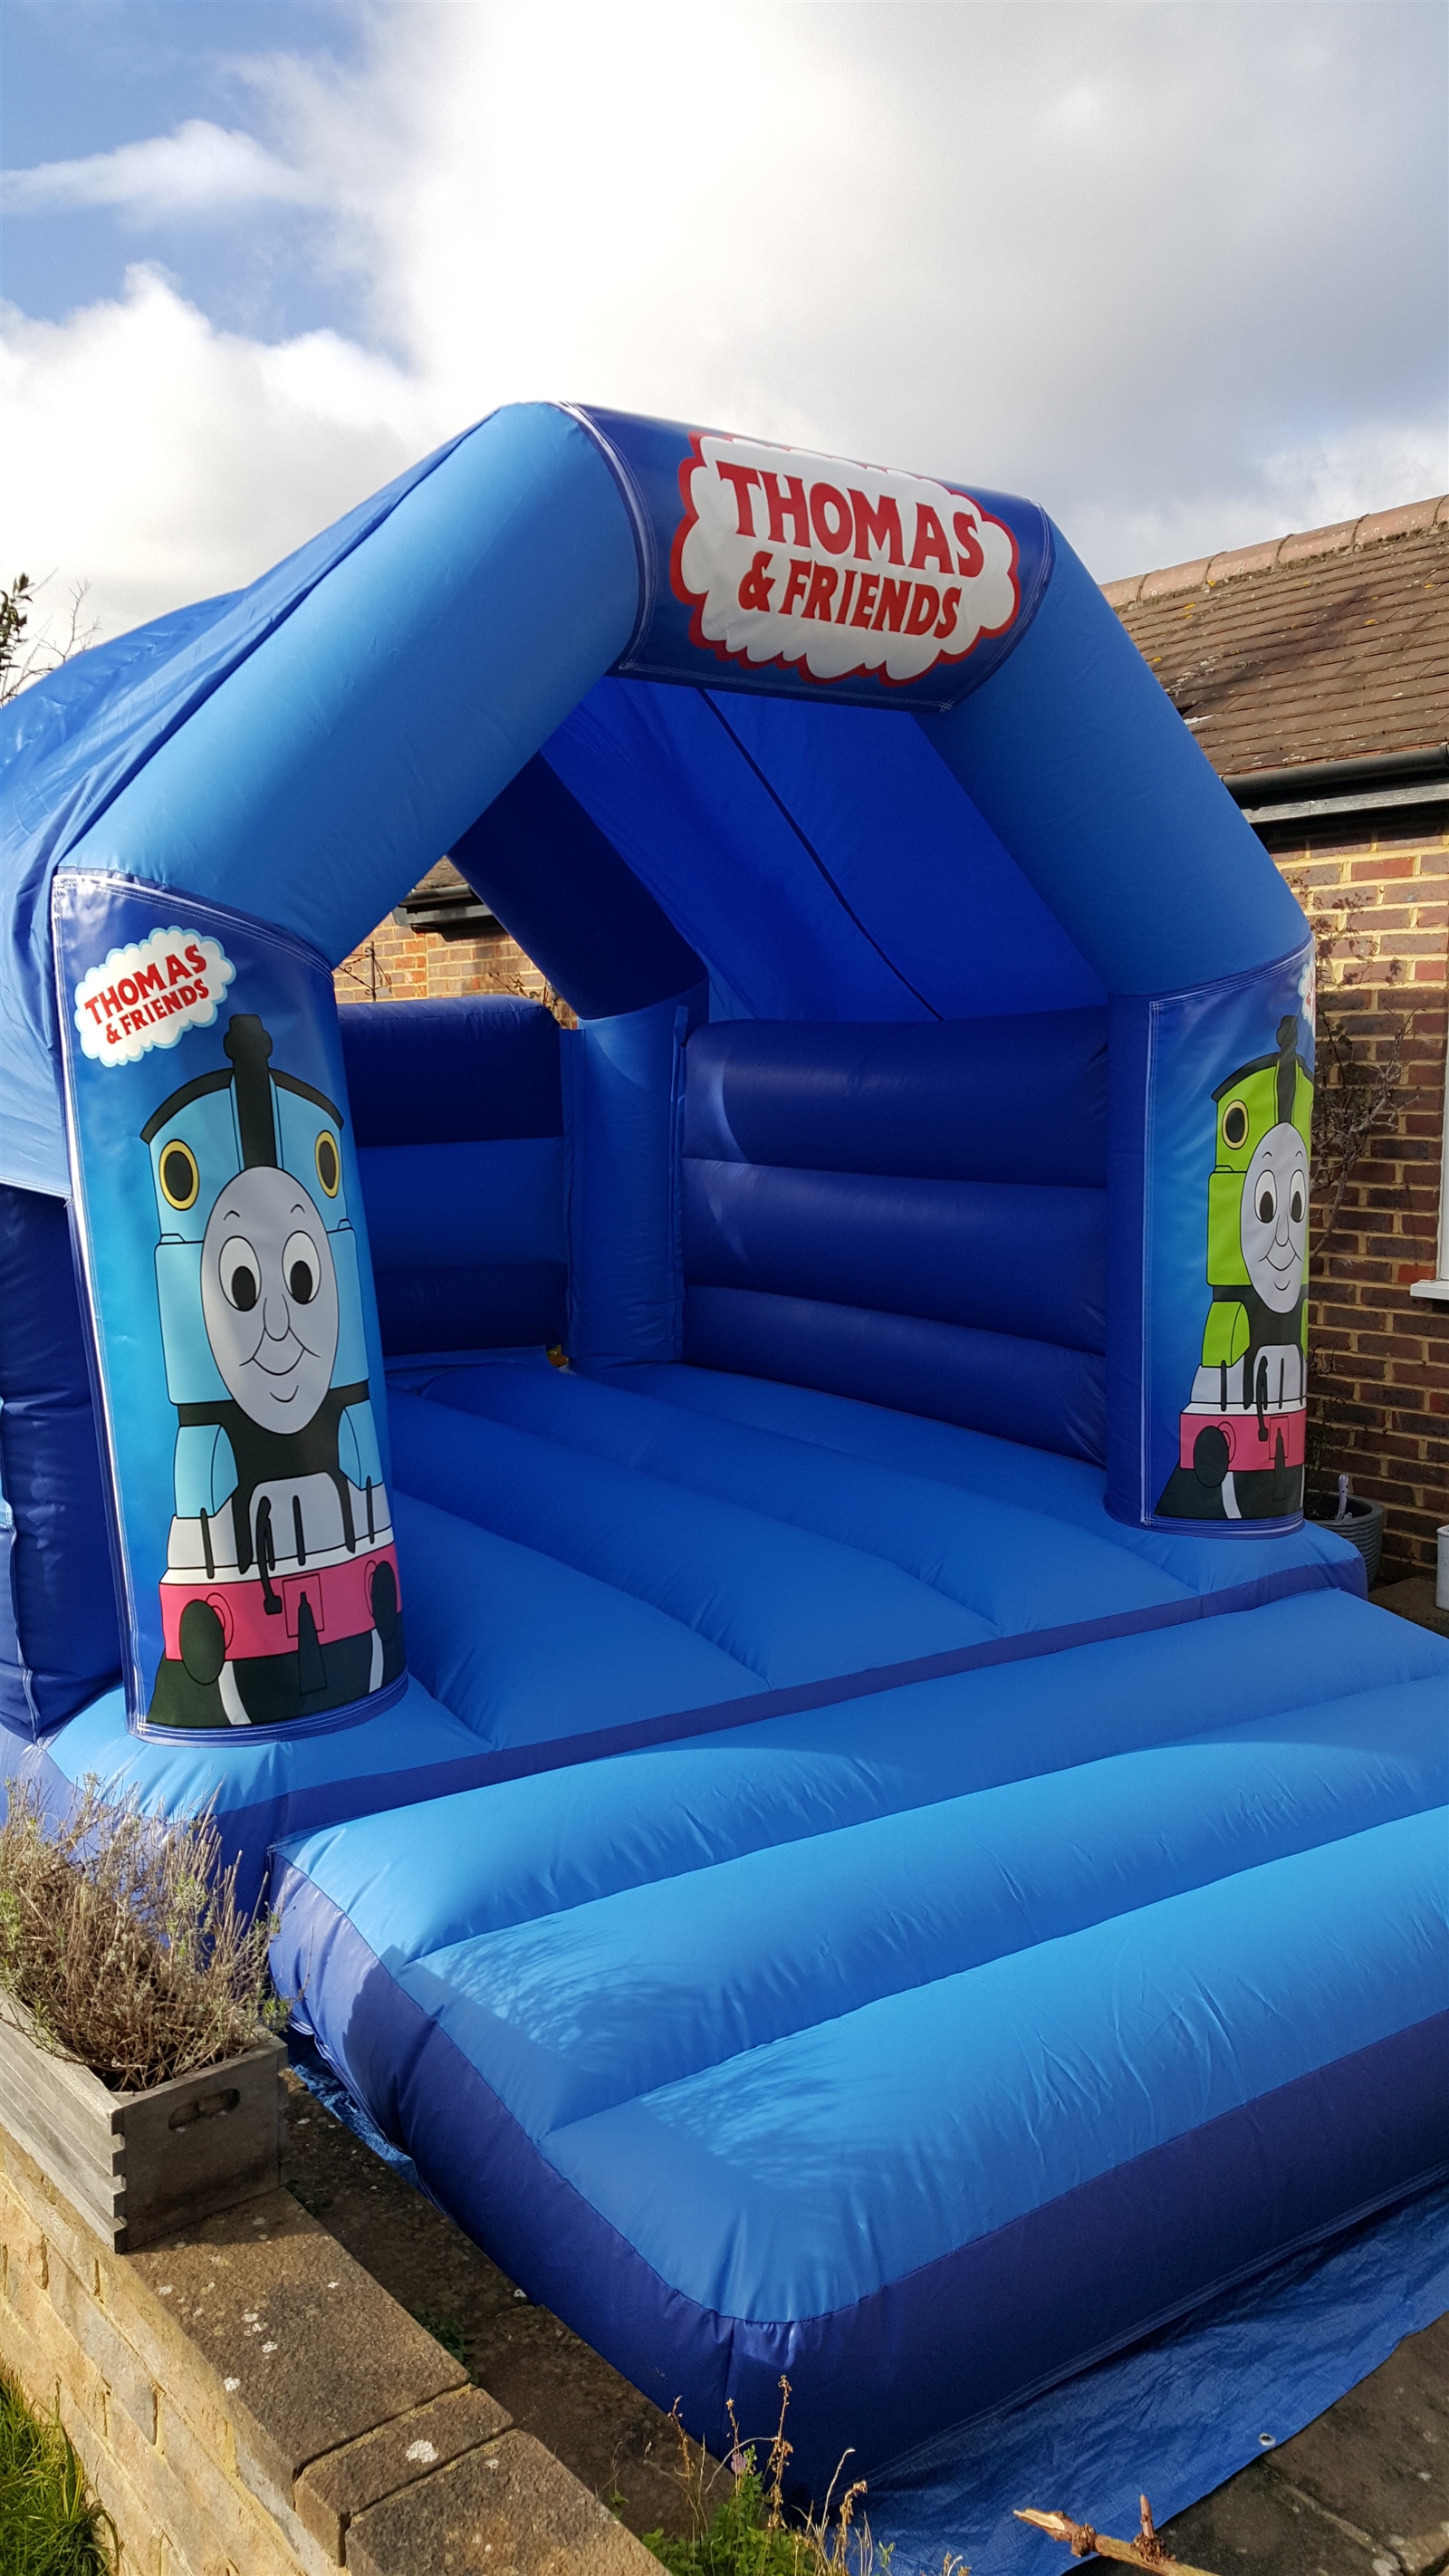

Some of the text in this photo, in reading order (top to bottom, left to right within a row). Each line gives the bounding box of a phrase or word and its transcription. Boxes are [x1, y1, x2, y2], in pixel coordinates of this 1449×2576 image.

[715, 460, 984, 578] THOMAS
[738, 551, 963, 639] & FRIENDS
[84, 944, 206, 1025] THOMAS
[105, 977, 209, 1044] & FRIENDS
